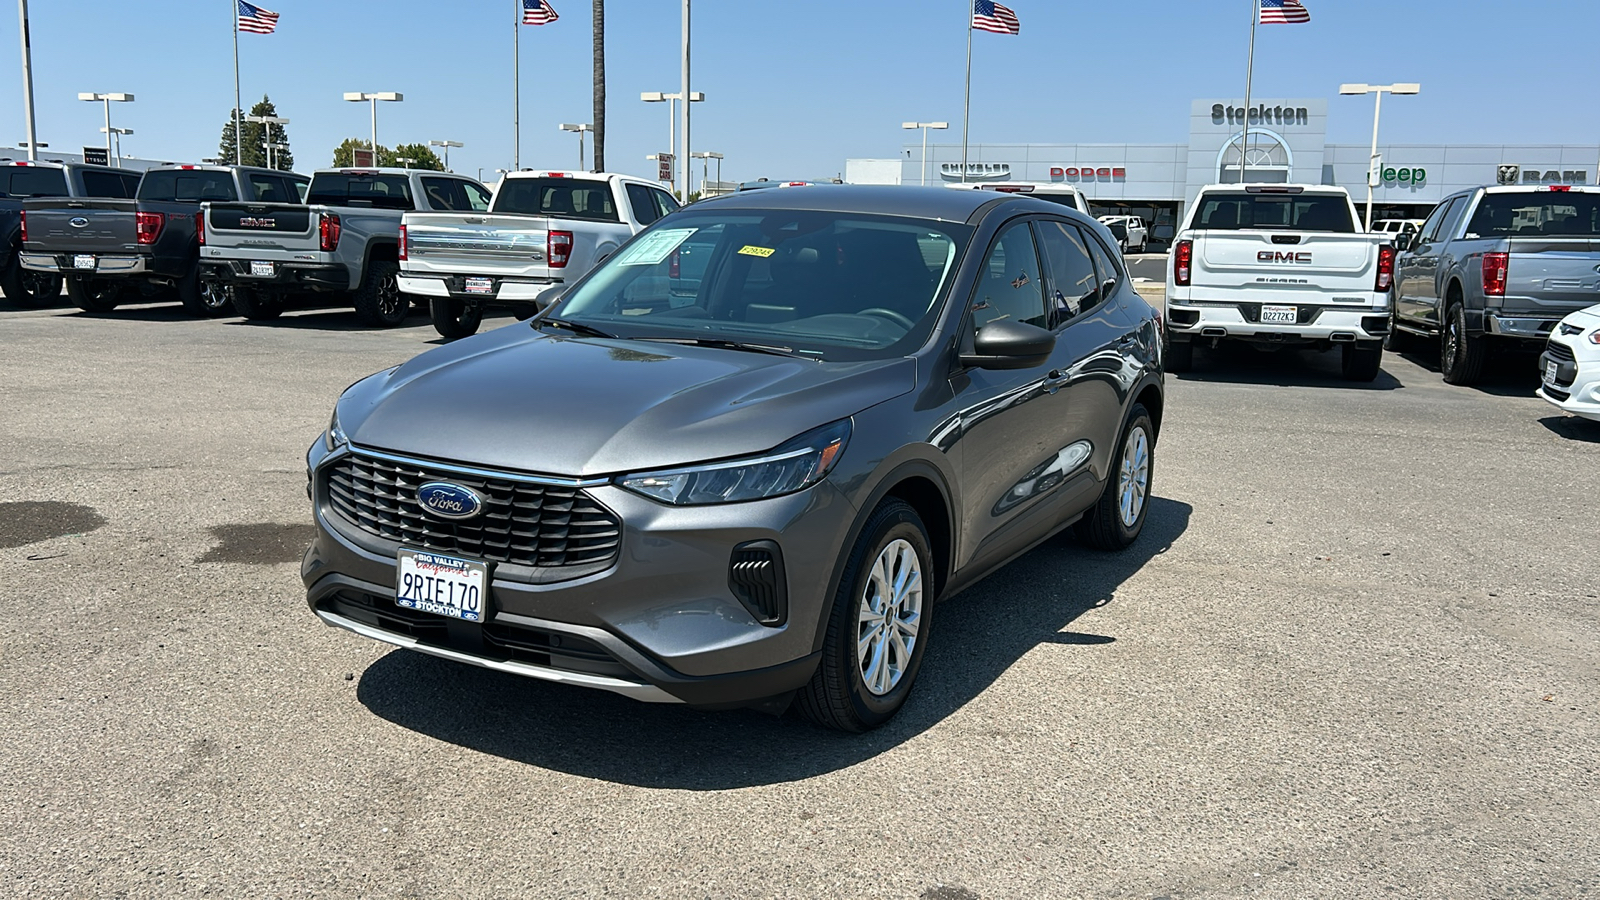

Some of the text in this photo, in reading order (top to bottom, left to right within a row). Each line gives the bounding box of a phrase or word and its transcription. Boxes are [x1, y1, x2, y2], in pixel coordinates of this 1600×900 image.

[1211, 103, 1308, 120] Stockton
[941, 163, 1010, 172] CHRYSLER
[1050, 167, 1126, 177] DODGE
[659, 170, 671, 180] CARS
[1522, 170, 1588, 183] RAM
[239, 217, 276, 227] GMC
[1257, 251, 1312, 262] GMC
[1263, 311, 1295, 322] 02272K3
[428, 489, 464, 512] Ford
[418, 553, 464, 568] BIG VALLEY
[403, 572, 479, 611] 9RIE170
[415, 600, 462, 617] STOCKTON
